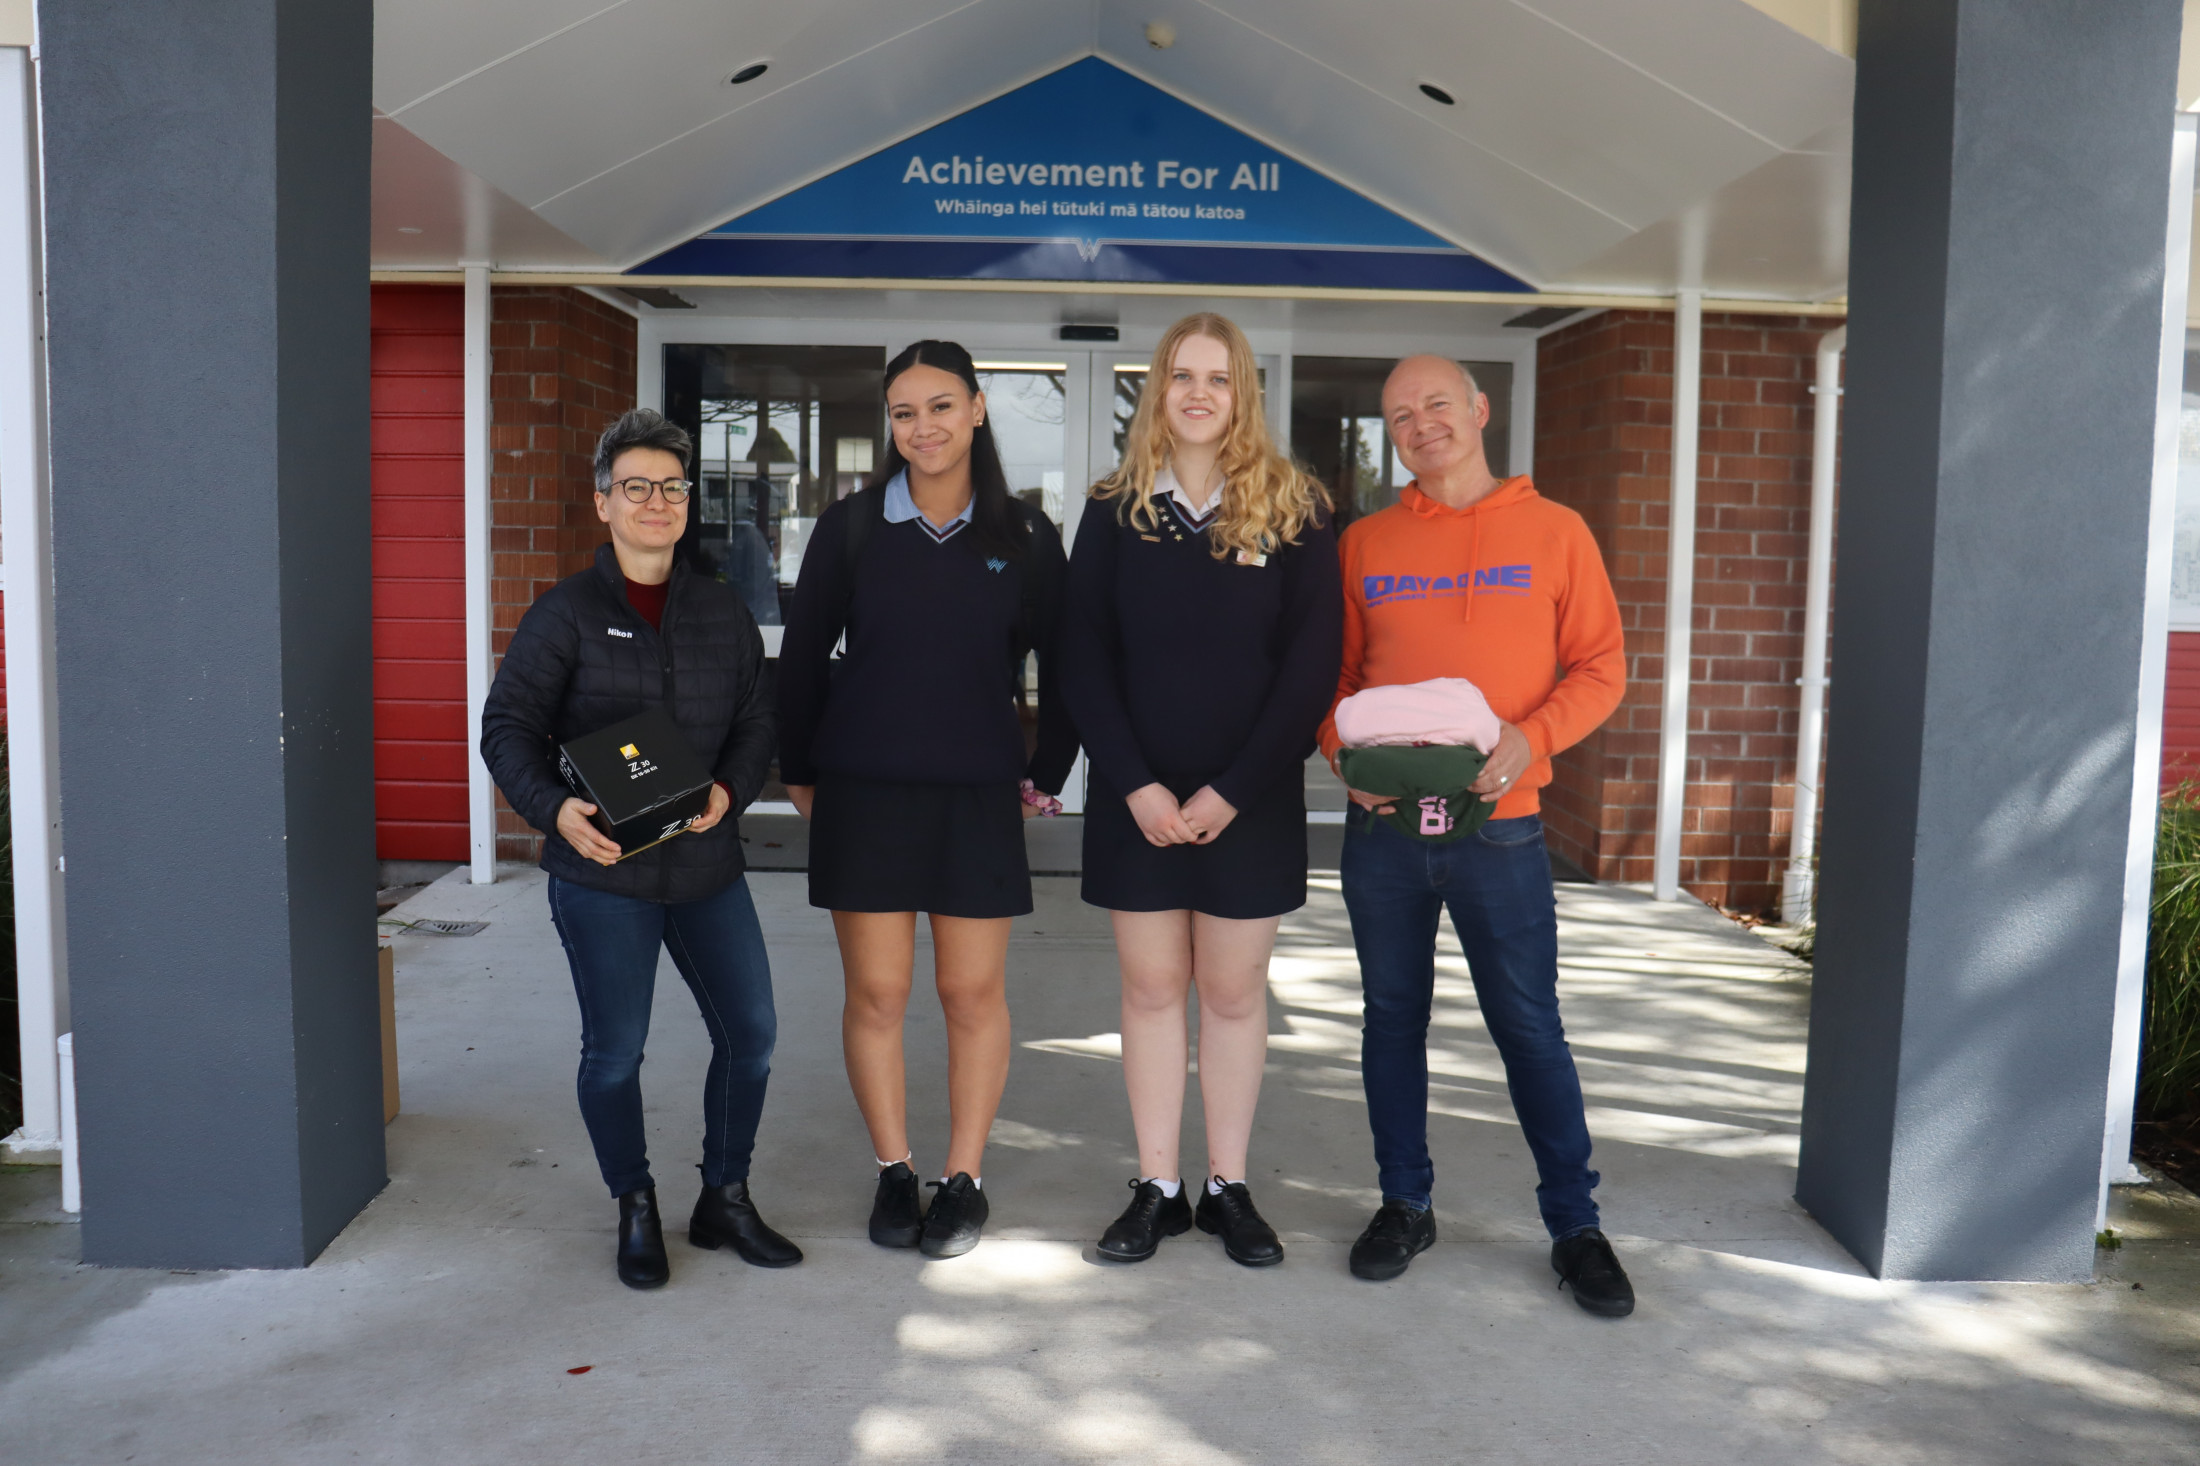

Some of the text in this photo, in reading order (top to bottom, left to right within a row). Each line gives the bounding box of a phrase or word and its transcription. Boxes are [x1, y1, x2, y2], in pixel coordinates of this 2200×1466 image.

[902, 155, 1279, 191] Achievement For All
[935, 199, 1245, 219] Whāinga hei tūtuki mā tātou katoa
[1363, 564, 1532, 600] DAY ONE
[607, 627, 633, 639] Nikon
[627, 759, 651, 773] Z 30
[658, 819, 682, 840] Z
